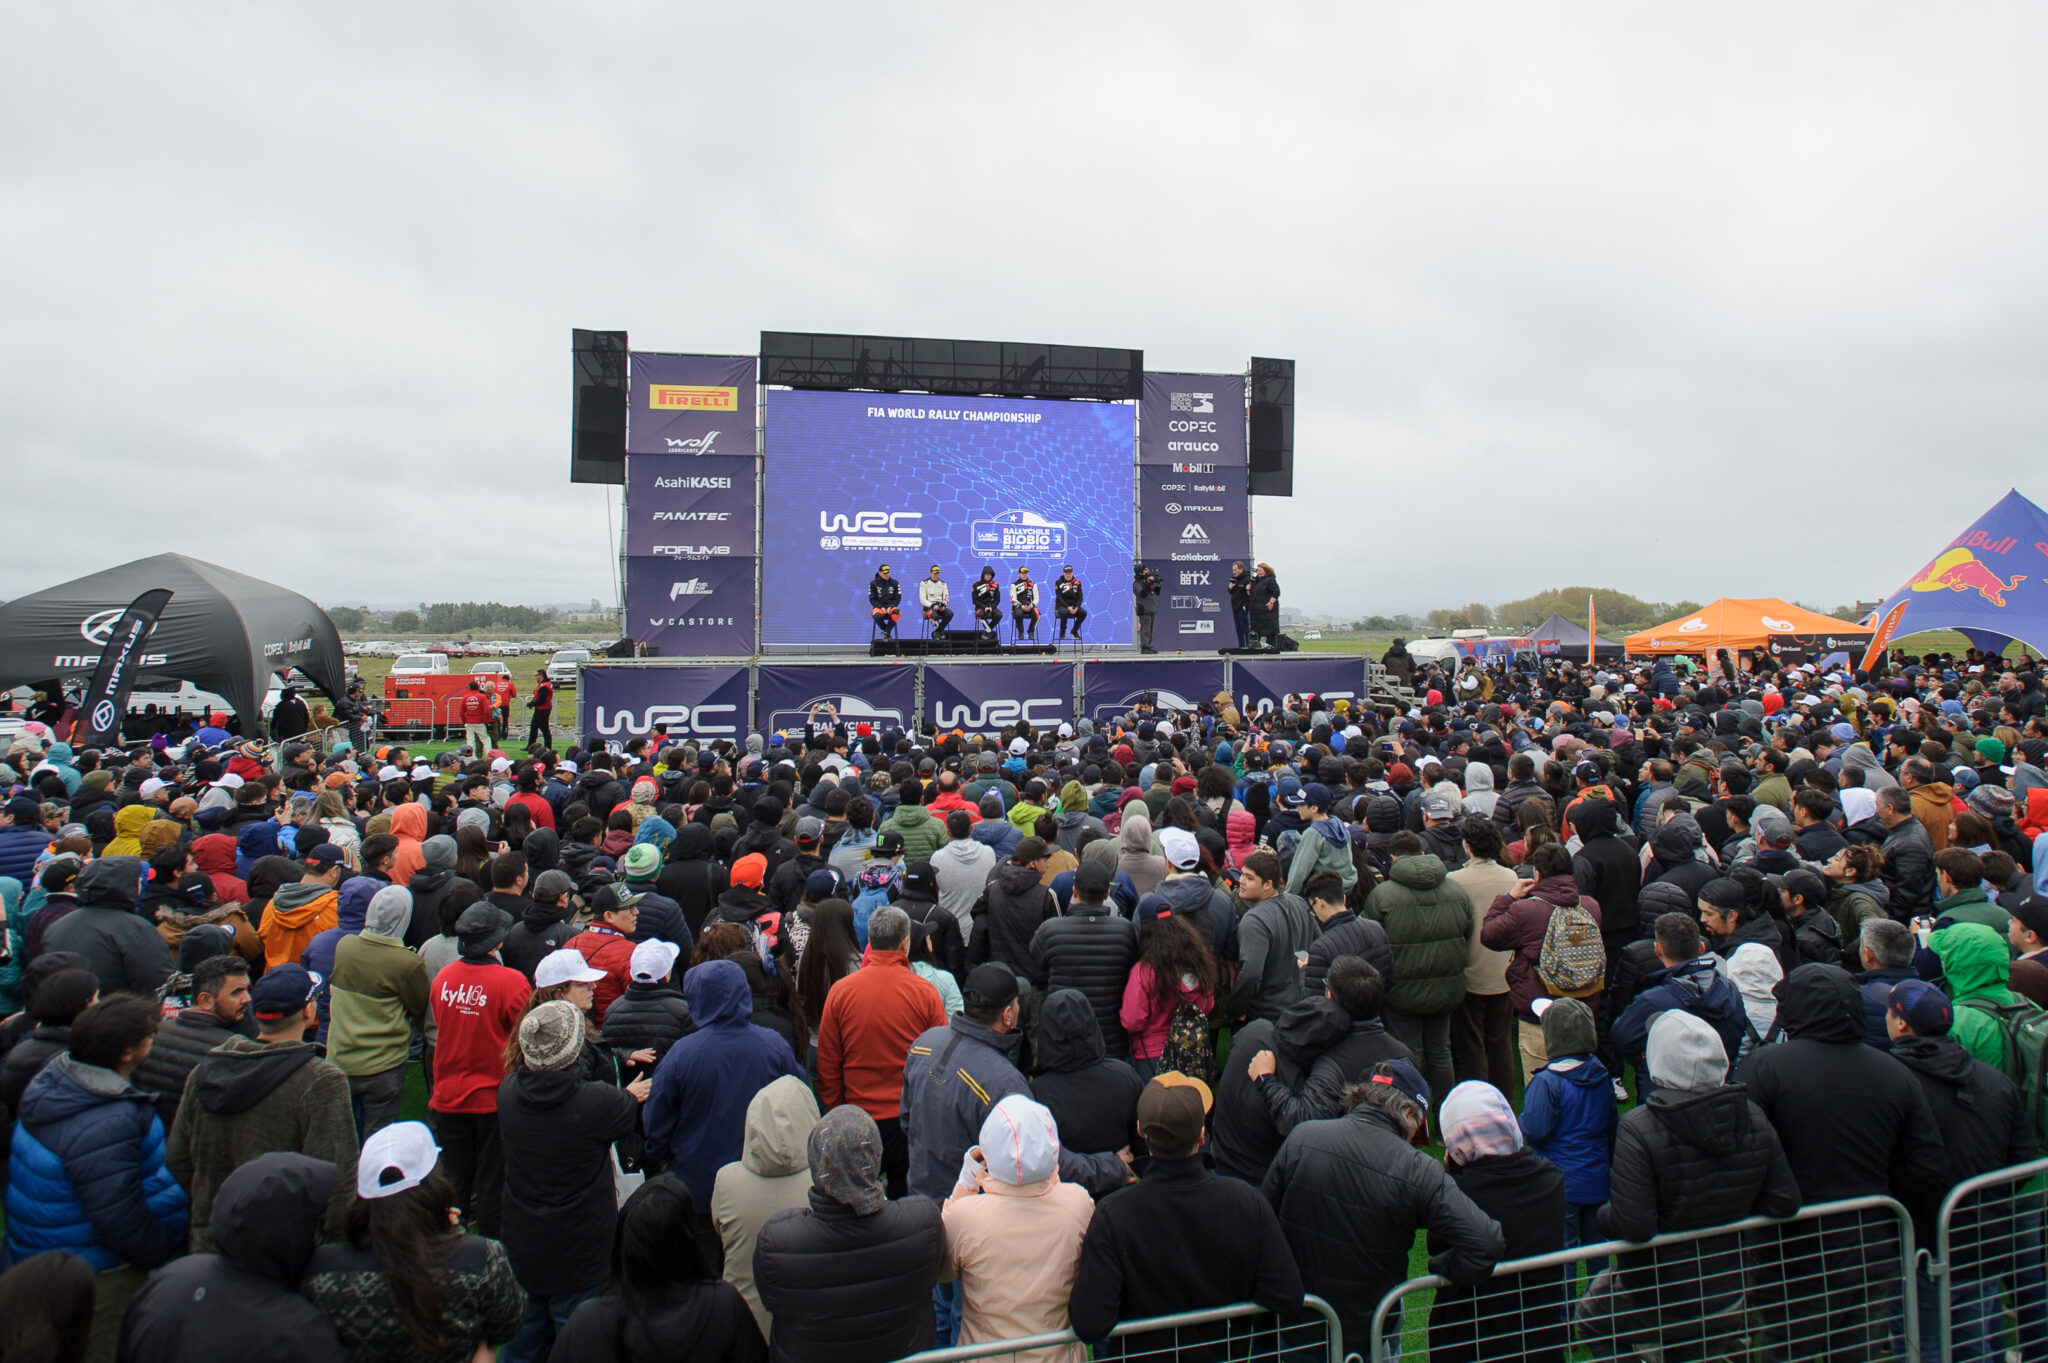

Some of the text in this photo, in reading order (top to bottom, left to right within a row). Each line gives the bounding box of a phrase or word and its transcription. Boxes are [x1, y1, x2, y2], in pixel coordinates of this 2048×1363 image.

[658, 389, 730, 406] PIRELLI
[867, 407, 1042, 424] FIA WORLD RALLY CHAMPIONSHIP
[1169, 420, 1217, 433] COPEC
[1168, 441, 1219, 452] arauco
[1172, 462, 1202, 473] Mobil
[654, 476, 731, 489] AsahiKASEI
[1161, 484, 1186, 492] COPEC
[652, 512, 729, 521] FANATEC
[820, 510, 922, 534] WRC
[1003, 527, 1050, 536] RALLYCHILE
[652, 545, 730, 555] FORUM8
[1171, 552, 1220, 561] Scotiabank
[668, 617, 733, 626] CASTORE
[54, 654, 168, 667] MAS
[104, 618, 144, 695] MAXUS
[596, 704, 737, 735] WRC
[936, 698, 1062, 728] WRC
[440, 981, 488, 1007] kyklos
